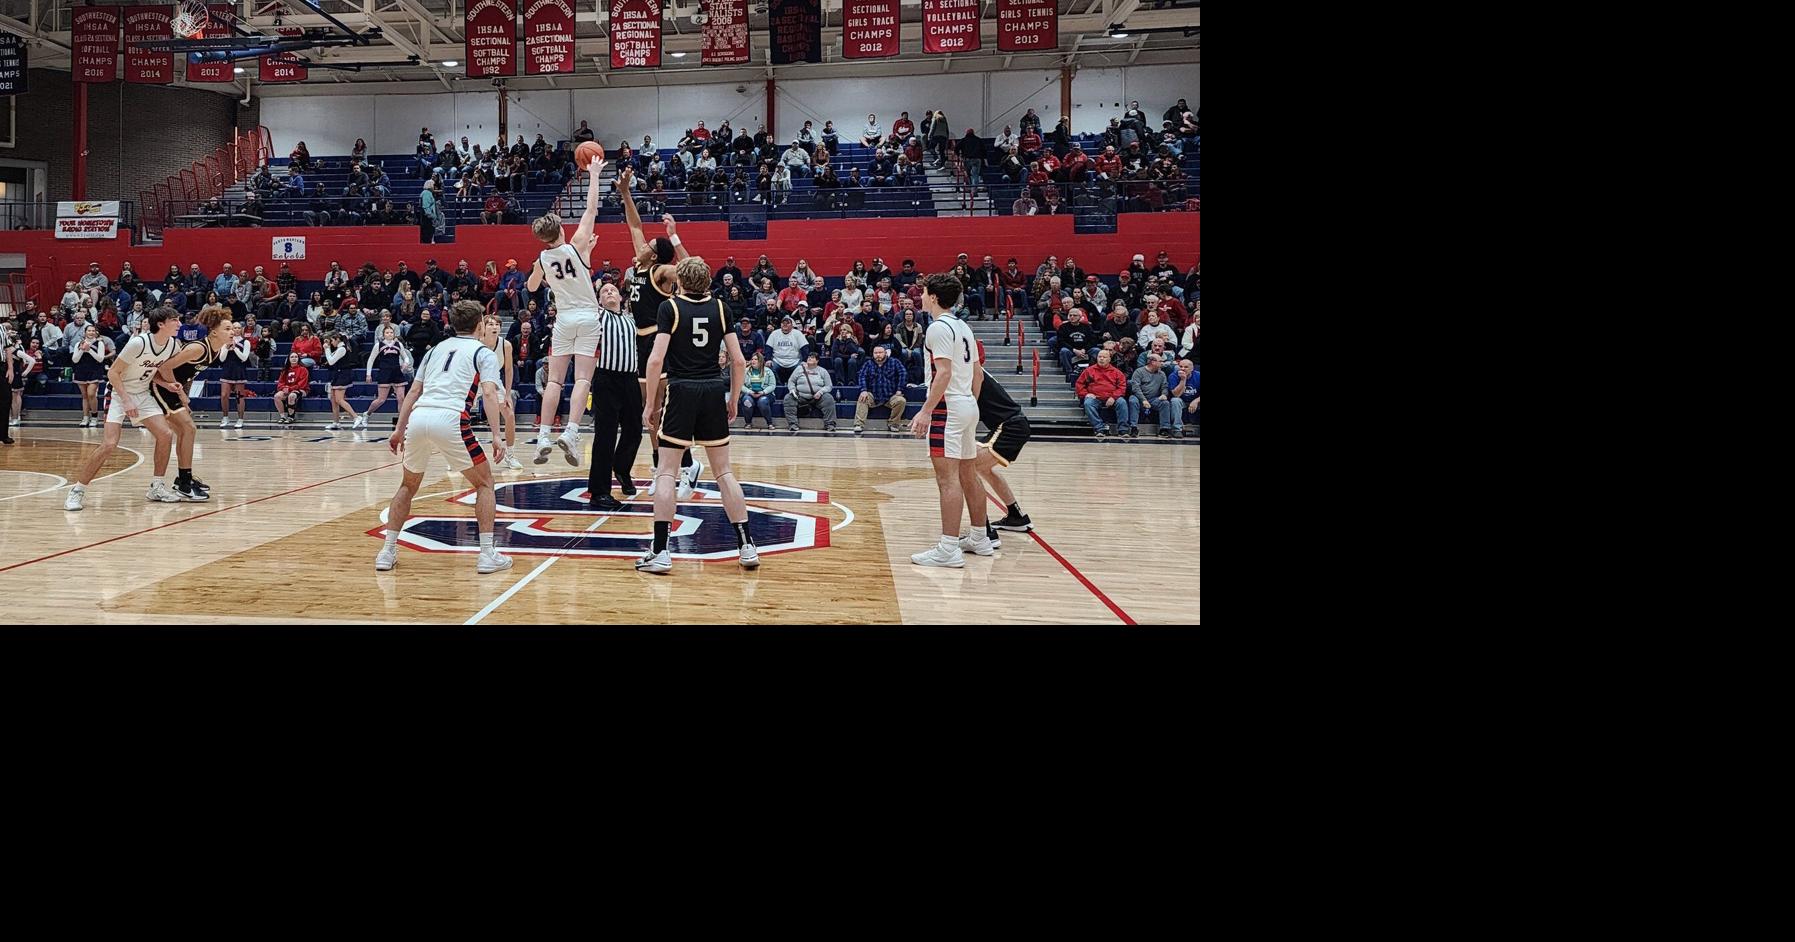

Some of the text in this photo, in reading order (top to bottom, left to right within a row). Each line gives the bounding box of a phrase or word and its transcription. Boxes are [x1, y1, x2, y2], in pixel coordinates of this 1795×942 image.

[709, 1, 734, 11] STATE
[852, 4, 890, 14] SECTIONAL
[924, 0, 978, 9] 2A SECTIONAL
[466, 0, 516, 22] SOUTHWESTERN
[524, 0, 575, 20] SOUTHWESTERN
[622, 11, 648, 19] IHSAA
[708, 8, 743, 18] NALISTS
[1000, 7, 1054, 19] GIRLS TENNIS
[75, 12, 118, 25] SOUTHWESTERN
[127, 12, 171, 24] SOUTHWESTERN
[711, 17, 733, 26] 2008
[847, 16, 894, 27] GIRLS TRACK
[926, 11, 976, 22] VOLLEYBALL
[83, 23, 109, 31] IHSAA
[135, 23, 161, 31] IHSAA
[477, 25, 504, 34] IHSAA
[535, 23, 563, 33] IHSAA
[611, 20, 660, 31] 2A SECTIONAL
[930, 24, 974, 35] CHAMPS
[1004, 21, 1049, 32] CHAMPS
[616, 30, 655, 40] REGIONAL
[850, 29, 892, 40] CHAMPS
[470, 37, 511, 46] SECTIONAL
[614, 40, 656, 50] SOFTBALL
[940, 38, 964, 48] 2012
[1014, 35, 1039, 45] 2013
[531, 45, 568, 55] SOFTBALL
[859, 42, 882, 51] 2012
[472, 48, 510, 58] SOFTBALL
[619, 48, 651, 58] CHAMPS
[79, 57, 113, 65] CHAMPS
[131, 58, 168, 66] CHAMPS
[476, 57, 507, 66] CHAMPS
[535, 54, 565, 64] CHAMPS
[625, 57, 646, 65] 2008
[84, 68, 104, 77] 2016
[200, 68, 220, 76] 2013
[274, 67, 294, 77] 2014
[482, 66, 500, 74] 1992
[539, 63, 560, 73] 2005
[140, 70, 161, 78] 2014
[0, 82, 13, 90] 021
[550, 258, 577, 280] 34
[630, 284, 641, 303] 25
[692, 317, 709, 348] 5
[962, 337, 971, 363] 3
[443, 350, 458, 372] 1
[139, 369, 153, 381] 5
